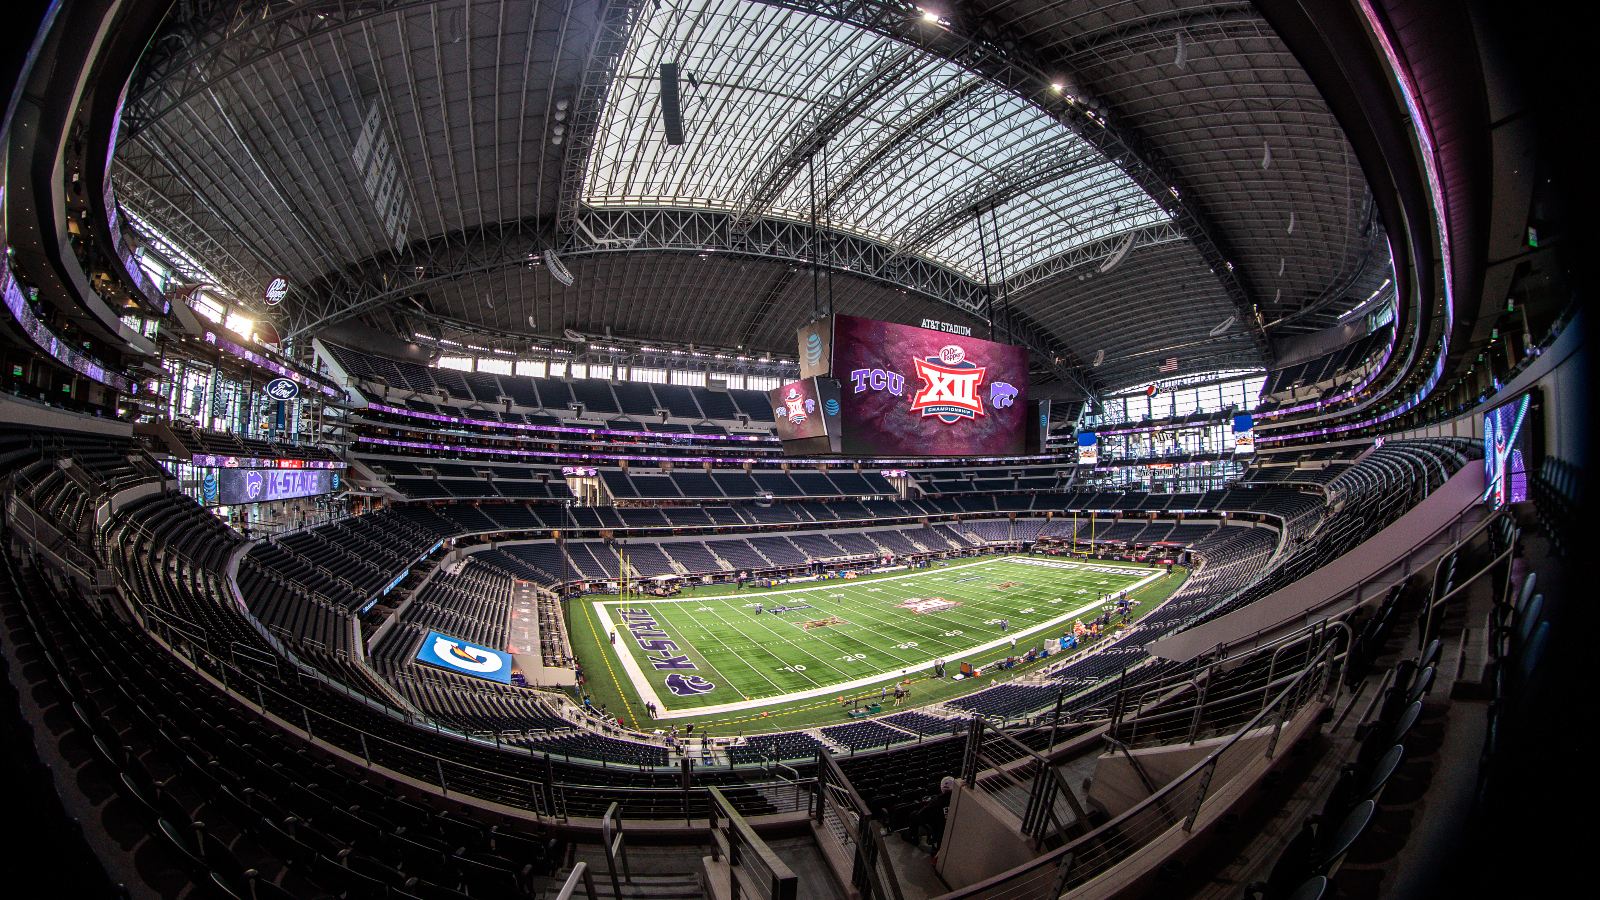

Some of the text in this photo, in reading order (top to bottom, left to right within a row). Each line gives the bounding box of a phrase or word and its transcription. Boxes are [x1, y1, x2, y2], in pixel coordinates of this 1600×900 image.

[921, 318, 972, 337] AT&T STADIUM
[941, 349, 962, 361] Pepper
[271, 381, 294, 398] Ford
[851, 369, 904, 396] TCU
[919, 365, 980, 408] XII
[927, 406, 971, 415] CHAMPIONSHIP
[1154, 468, 1180, 476] STADIUM
[267, 472, 317, 496] K-STATE
[616, 608, 699, 671] K-STATE
[433, 636, 503, 673] G
[842, 653, 867, 662] 20
[784, 664, 807, 673] 10
